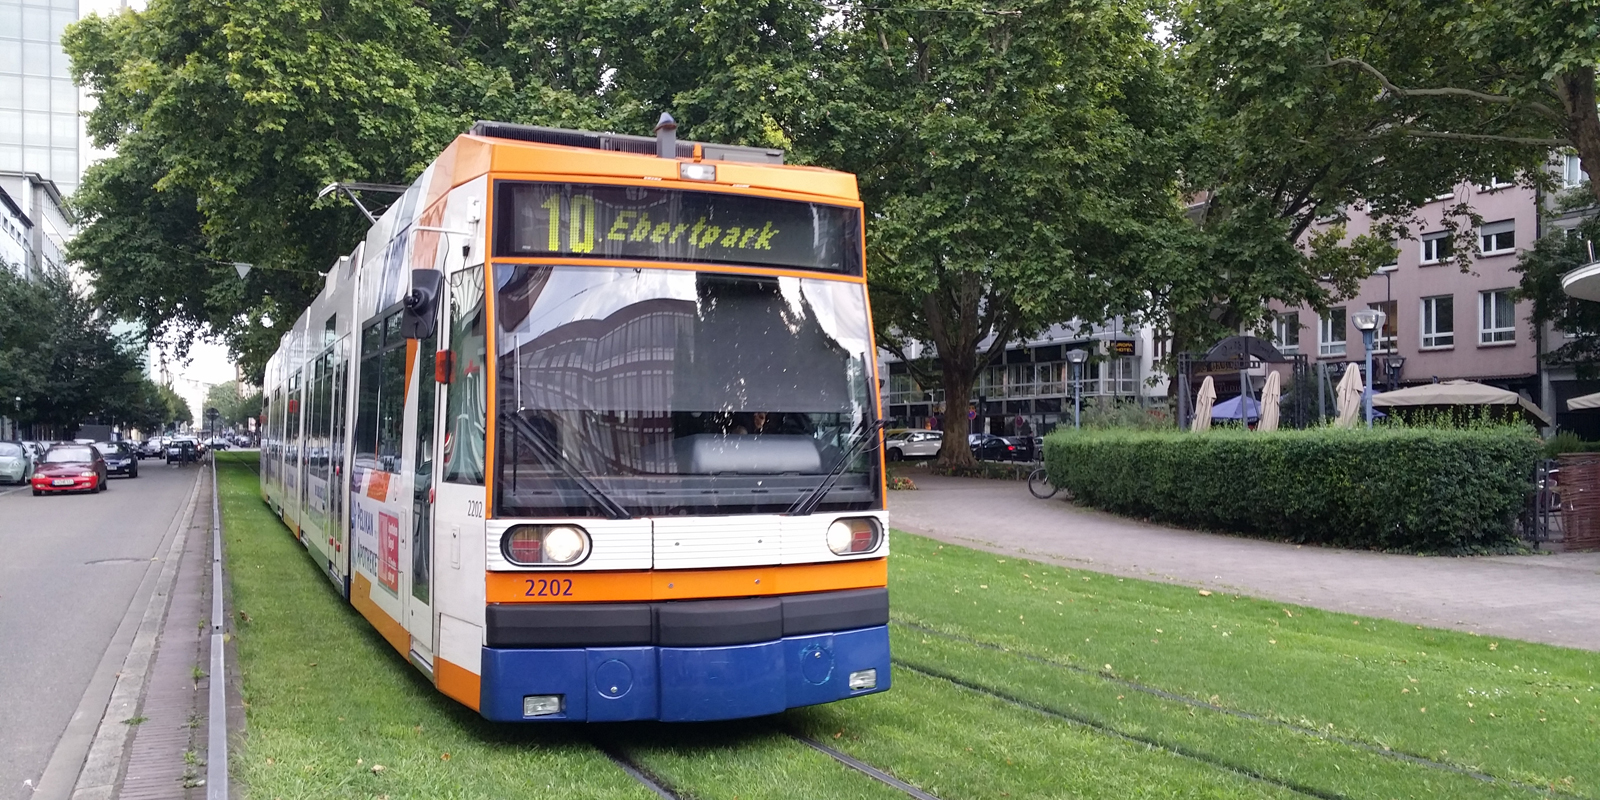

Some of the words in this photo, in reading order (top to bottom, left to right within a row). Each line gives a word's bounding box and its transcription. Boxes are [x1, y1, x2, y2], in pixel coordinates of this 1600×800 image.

[541, 193, 595, 253] 10
[607, 210, 779, 250] Ebertpark
[357, 502, 374, 537] PELIKAN
[467, 499, 483, 518] 2202
[357, 537, 378, 577] APOTHEKE
[525, 579, 573, 596] 2202
